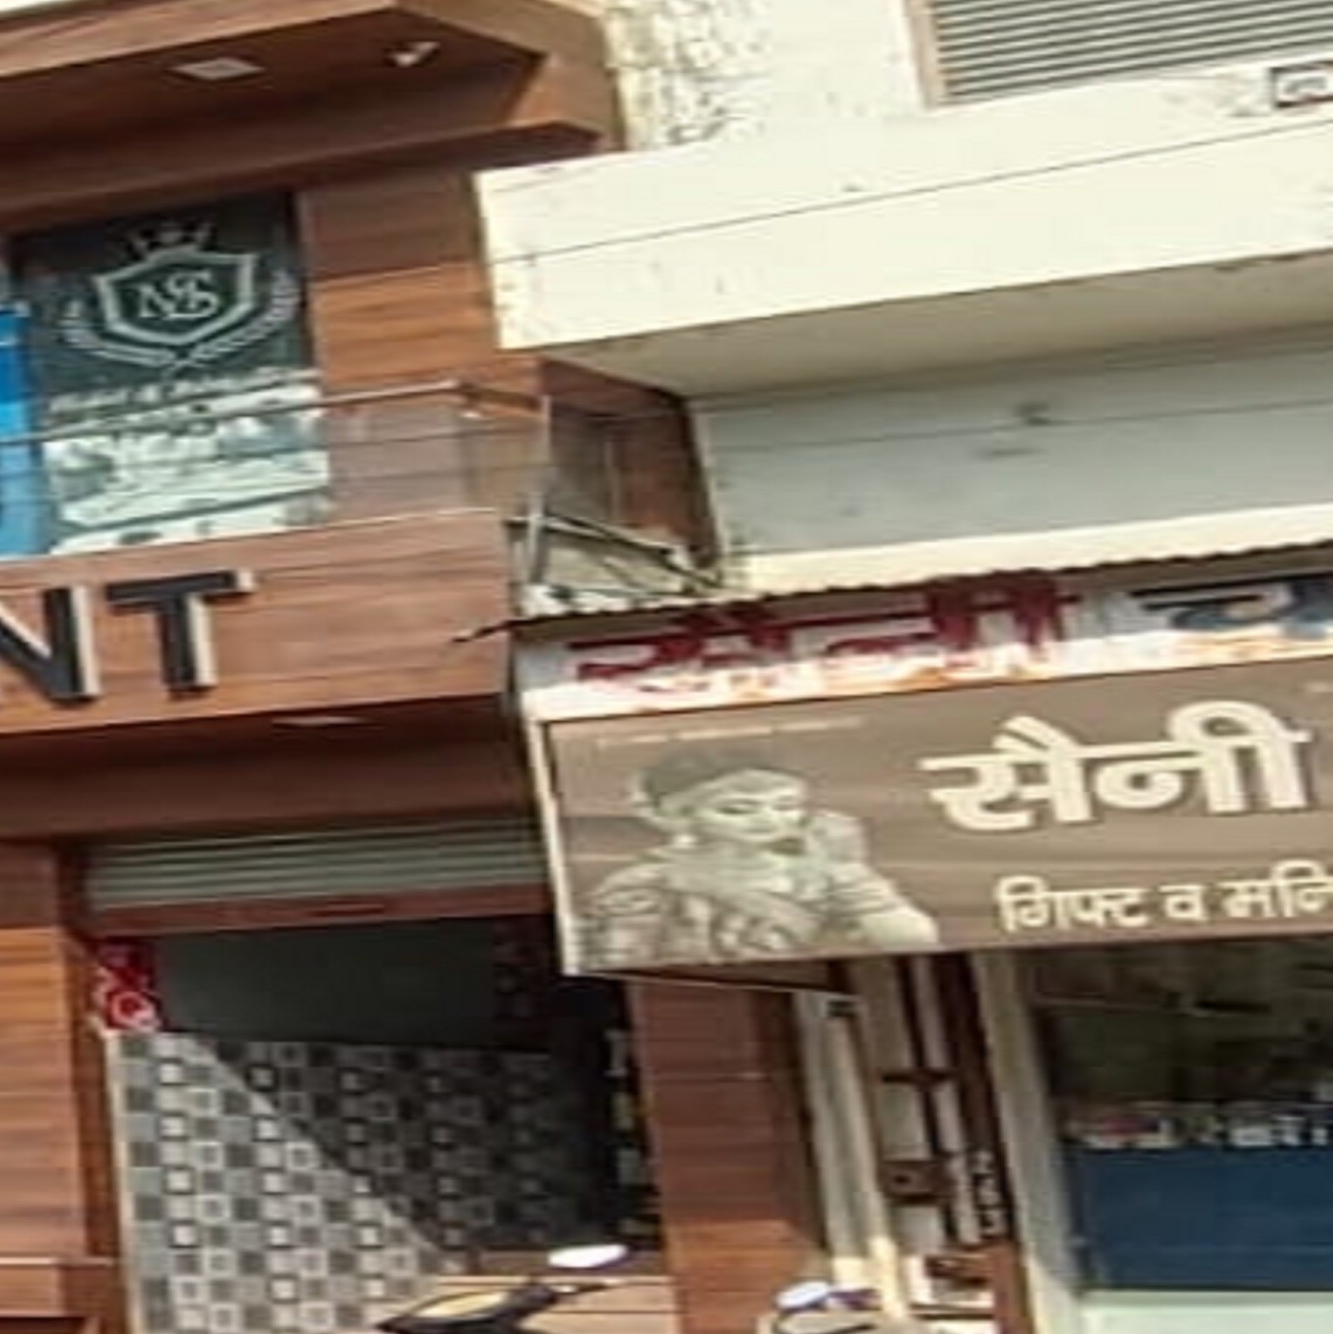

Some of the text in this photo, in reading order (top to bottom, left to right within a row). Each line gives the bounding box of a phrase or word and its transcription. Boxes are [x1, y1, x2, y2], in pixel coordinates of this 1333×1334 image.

[919, 701, 1312, 830] सैनी
[996, 874, 1150, 934] गिफ्ट
[1159, 886, 1209, 924] व
